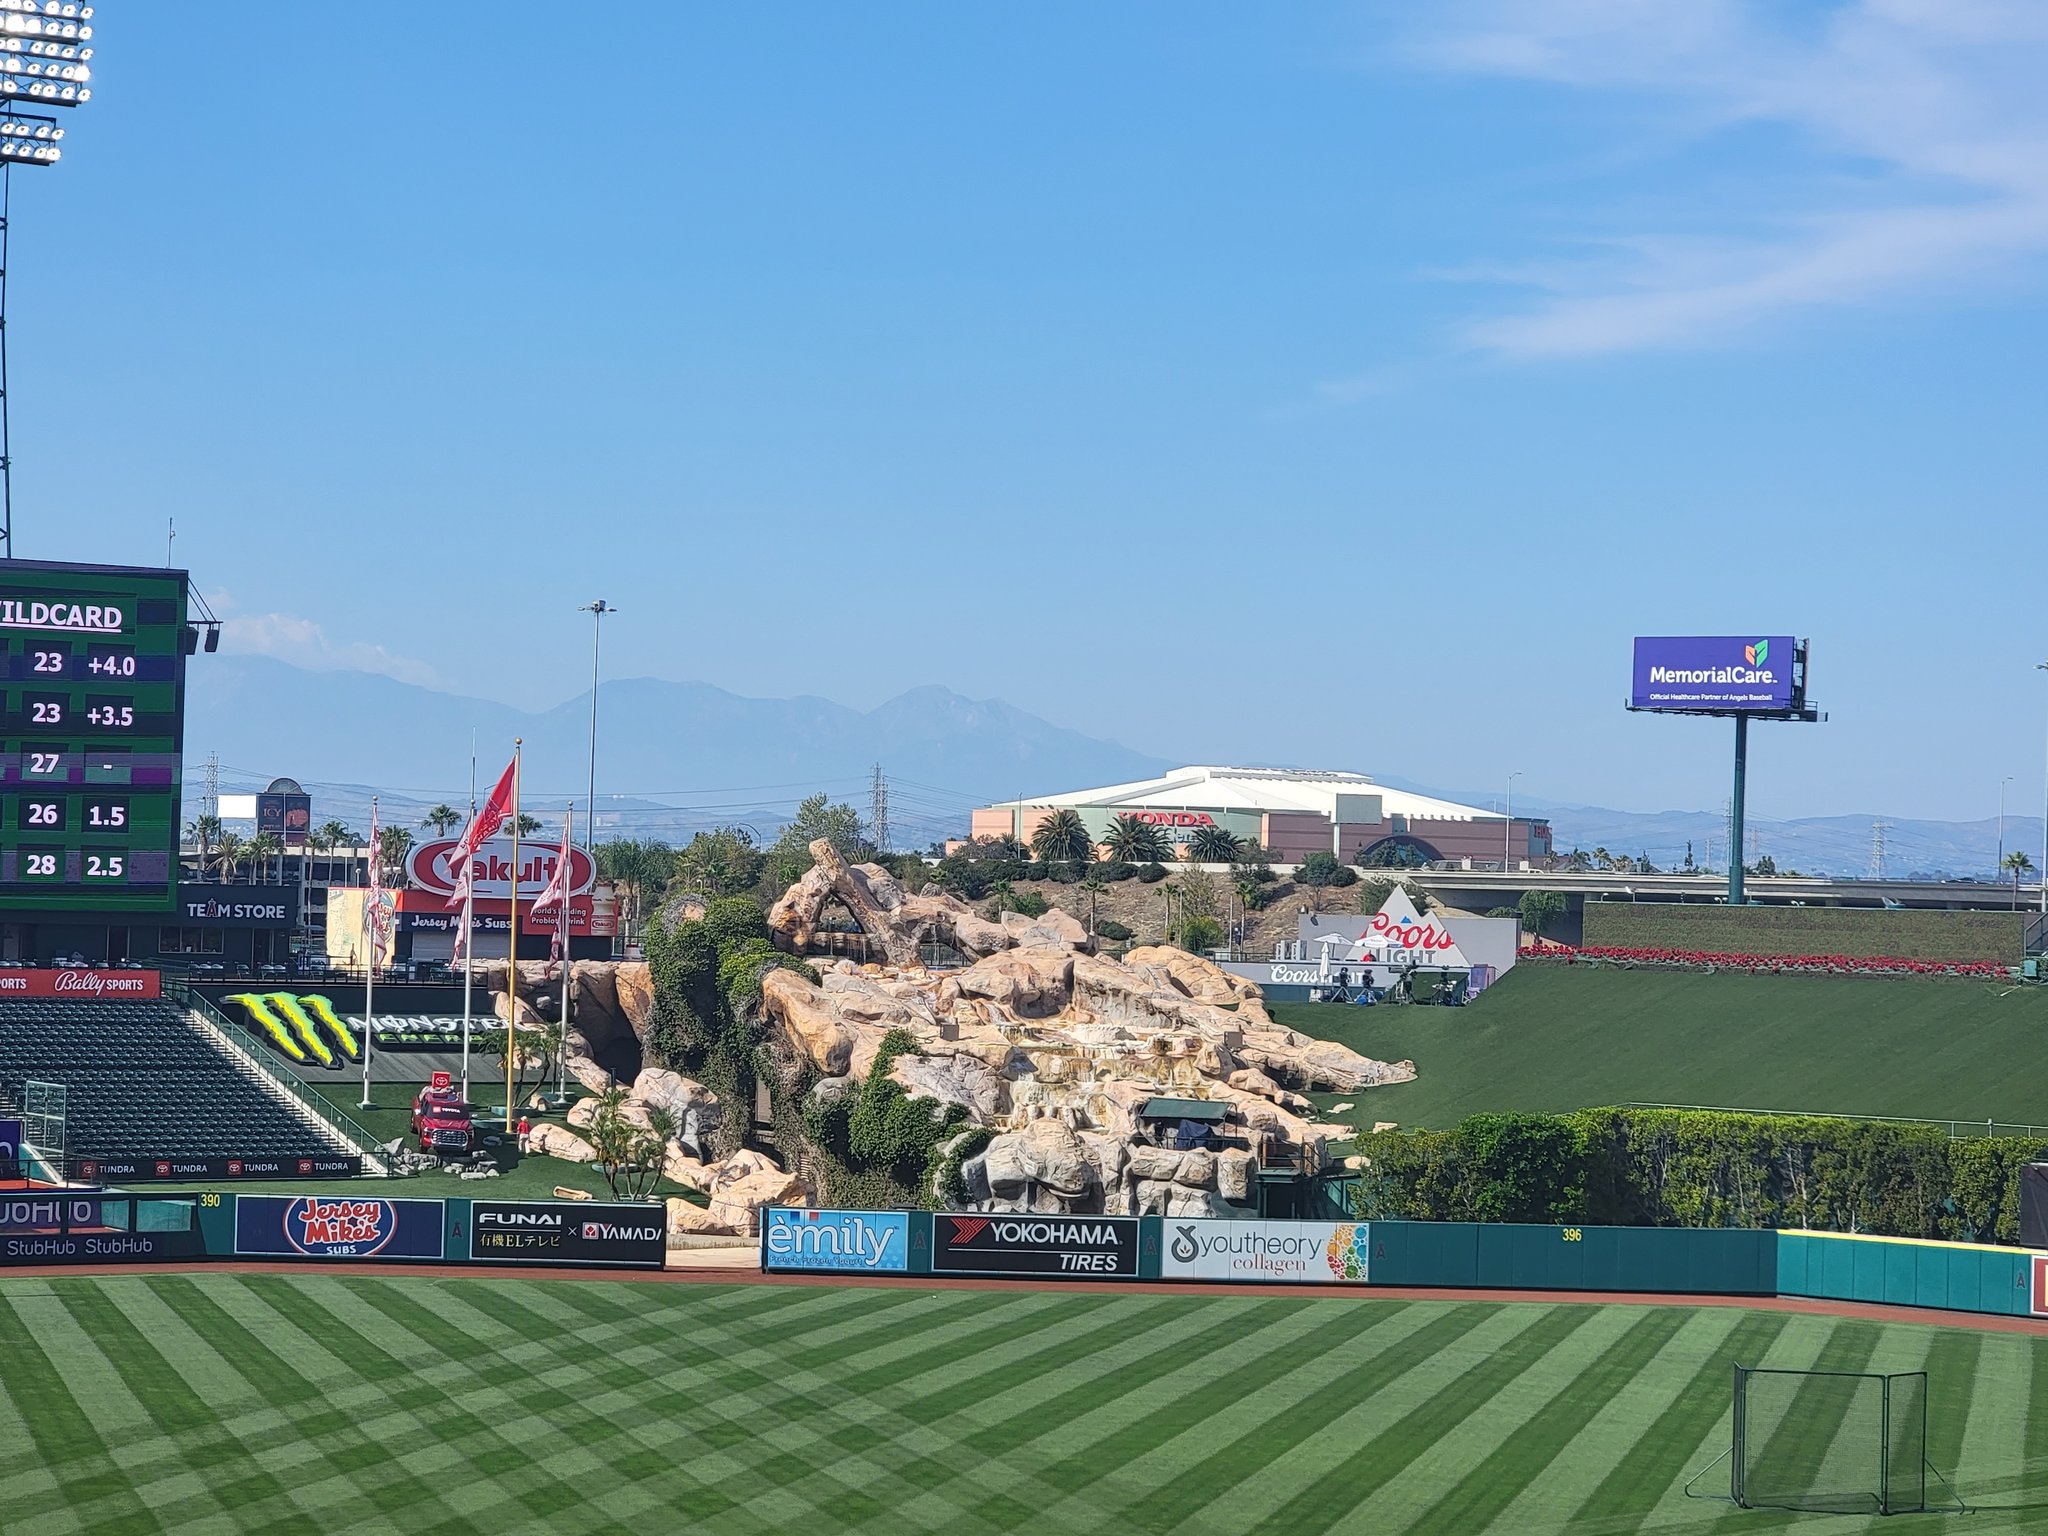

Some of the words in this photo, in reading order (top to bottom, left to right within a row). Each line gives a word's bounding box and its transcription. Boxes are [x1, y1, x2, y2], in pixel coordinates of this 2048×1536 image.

[0, 600, 122, 628] ILDCARD
[33, 652, 63, 672] 23
[88, 656, 136, 676] +4.0
[1729, 694, 1748, 702] Angels
[32, 703, 61, 723] 23
[87, 707, 133, 727] +3.5
[30, 753, 59, 773] 27
[28, 804, 57, 824] 26
[89, 806, 125, 826] 1.5
[26, 855, 56, 875] 28
[87, 856, 122, 877] 2.5
[442, 854, 562, 884] Yakult
[186, 898, 231, 918] TEAM
[234, 904, 285, 918] STORE
[411, 914, 447, 930] Jersey
[449, 916, 483, 928] Me's
[567, 917, 585, 925] rink
[1360, 912, 1455, 950] Coors
[54, 970, 107, 996] Bally
[106, 979, 144, 990] SPORTS
[1270, 964, 1319, 983] Coors
[0, 978, 27, 989] ORTS
[99, 1165, 136, 1174] TUNDRA
[172, 1164, 208, 1173] TUNDRA
[243, 1163, 279, 1172] TUNDRA
[314, 1162, 349, 1171] TUNDRA
[201, 1194, 221, 1208] 390
[298, 1198, 382, 1222] Jersey
[479, 1213, 562, 1226] FUNAI
[304, 1219, 381, 1245] Mike's
[990, 1222, 1119, 1245] YOKOHAMA
[1562, 1228, 1582, 1241] 396
[7, 1240, 76, 1256] StubHub
[85, 1237, 153, 1255] StubHub
[326, 1245, 357, 1255] SUBS
[1199, 1231, 1322, 1260] youtheory
[769, 1255, 799, 1264] French
[801, 1256, 832, 1265] Frozen
[833, 1256, 863, 1266] Yogurt
[1059, 1254, 1119, 1272] TIRES
[1233, 1253, 1306, 1276] collagen
